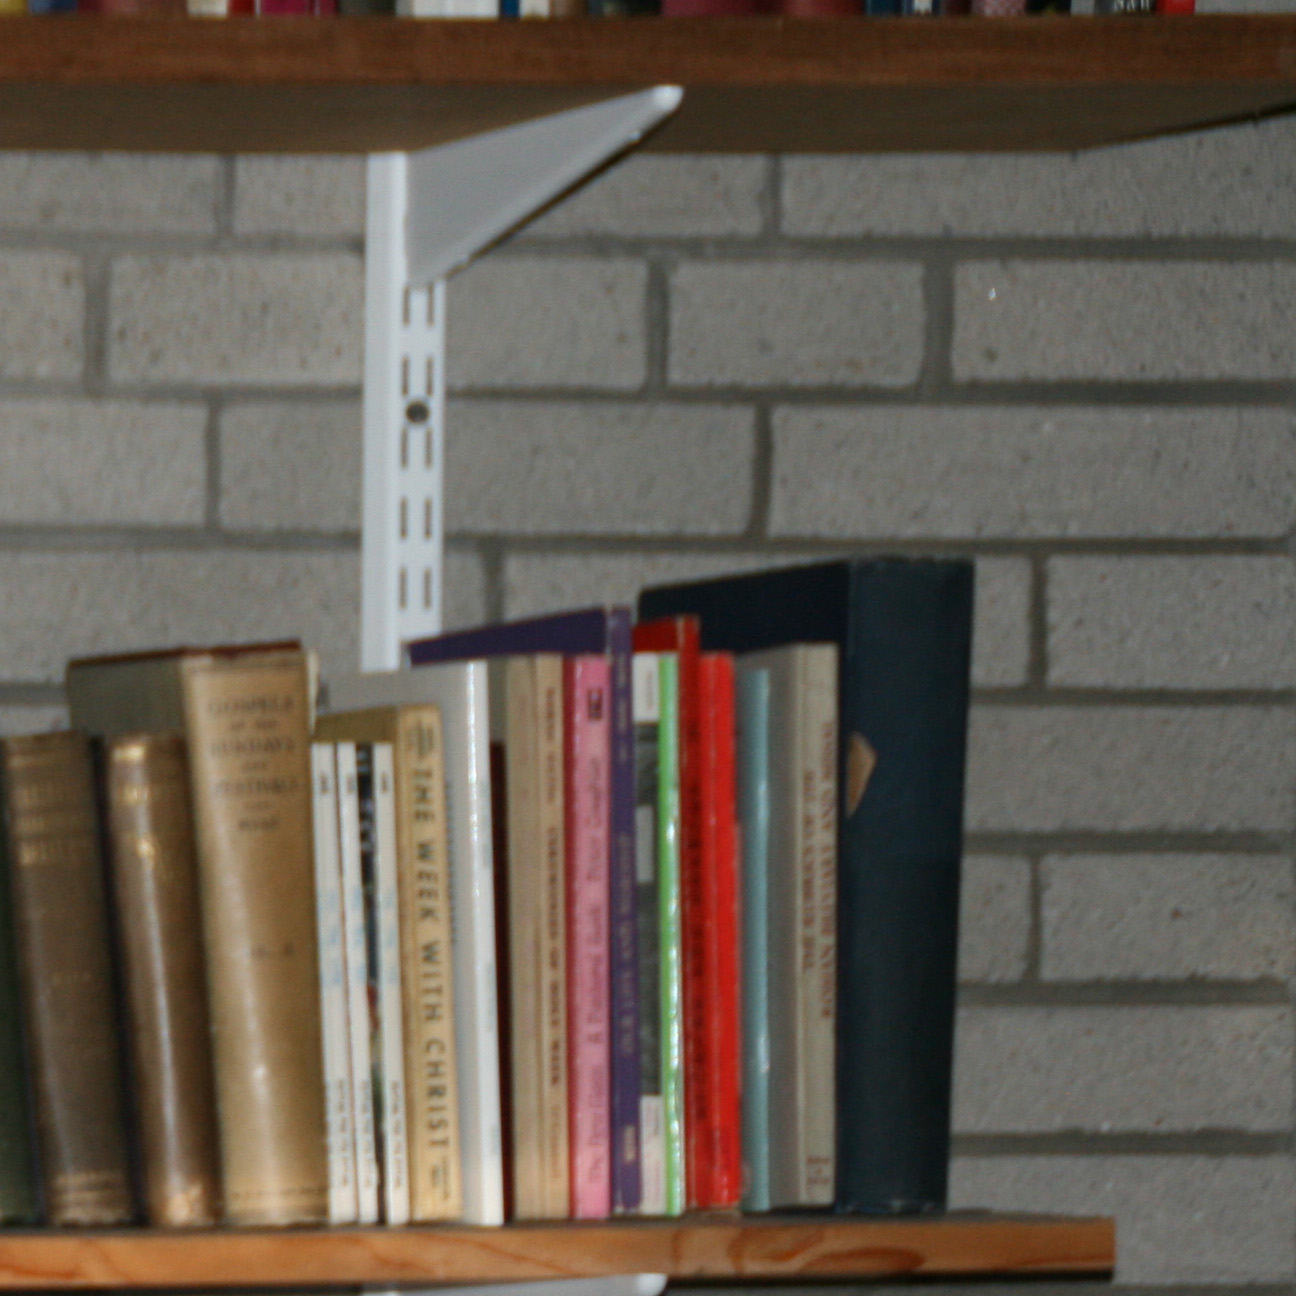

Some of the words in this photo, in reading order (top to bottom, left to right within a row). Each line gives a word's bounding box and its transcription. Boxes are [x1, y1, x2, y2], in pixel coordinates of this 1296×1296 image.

[412, 768, 435, 822] THE
[416, 841, 441, 920] WEEK
[421, 939, 444, 1021] WITH
[425, 1038, 450, 1148] CHRIST
